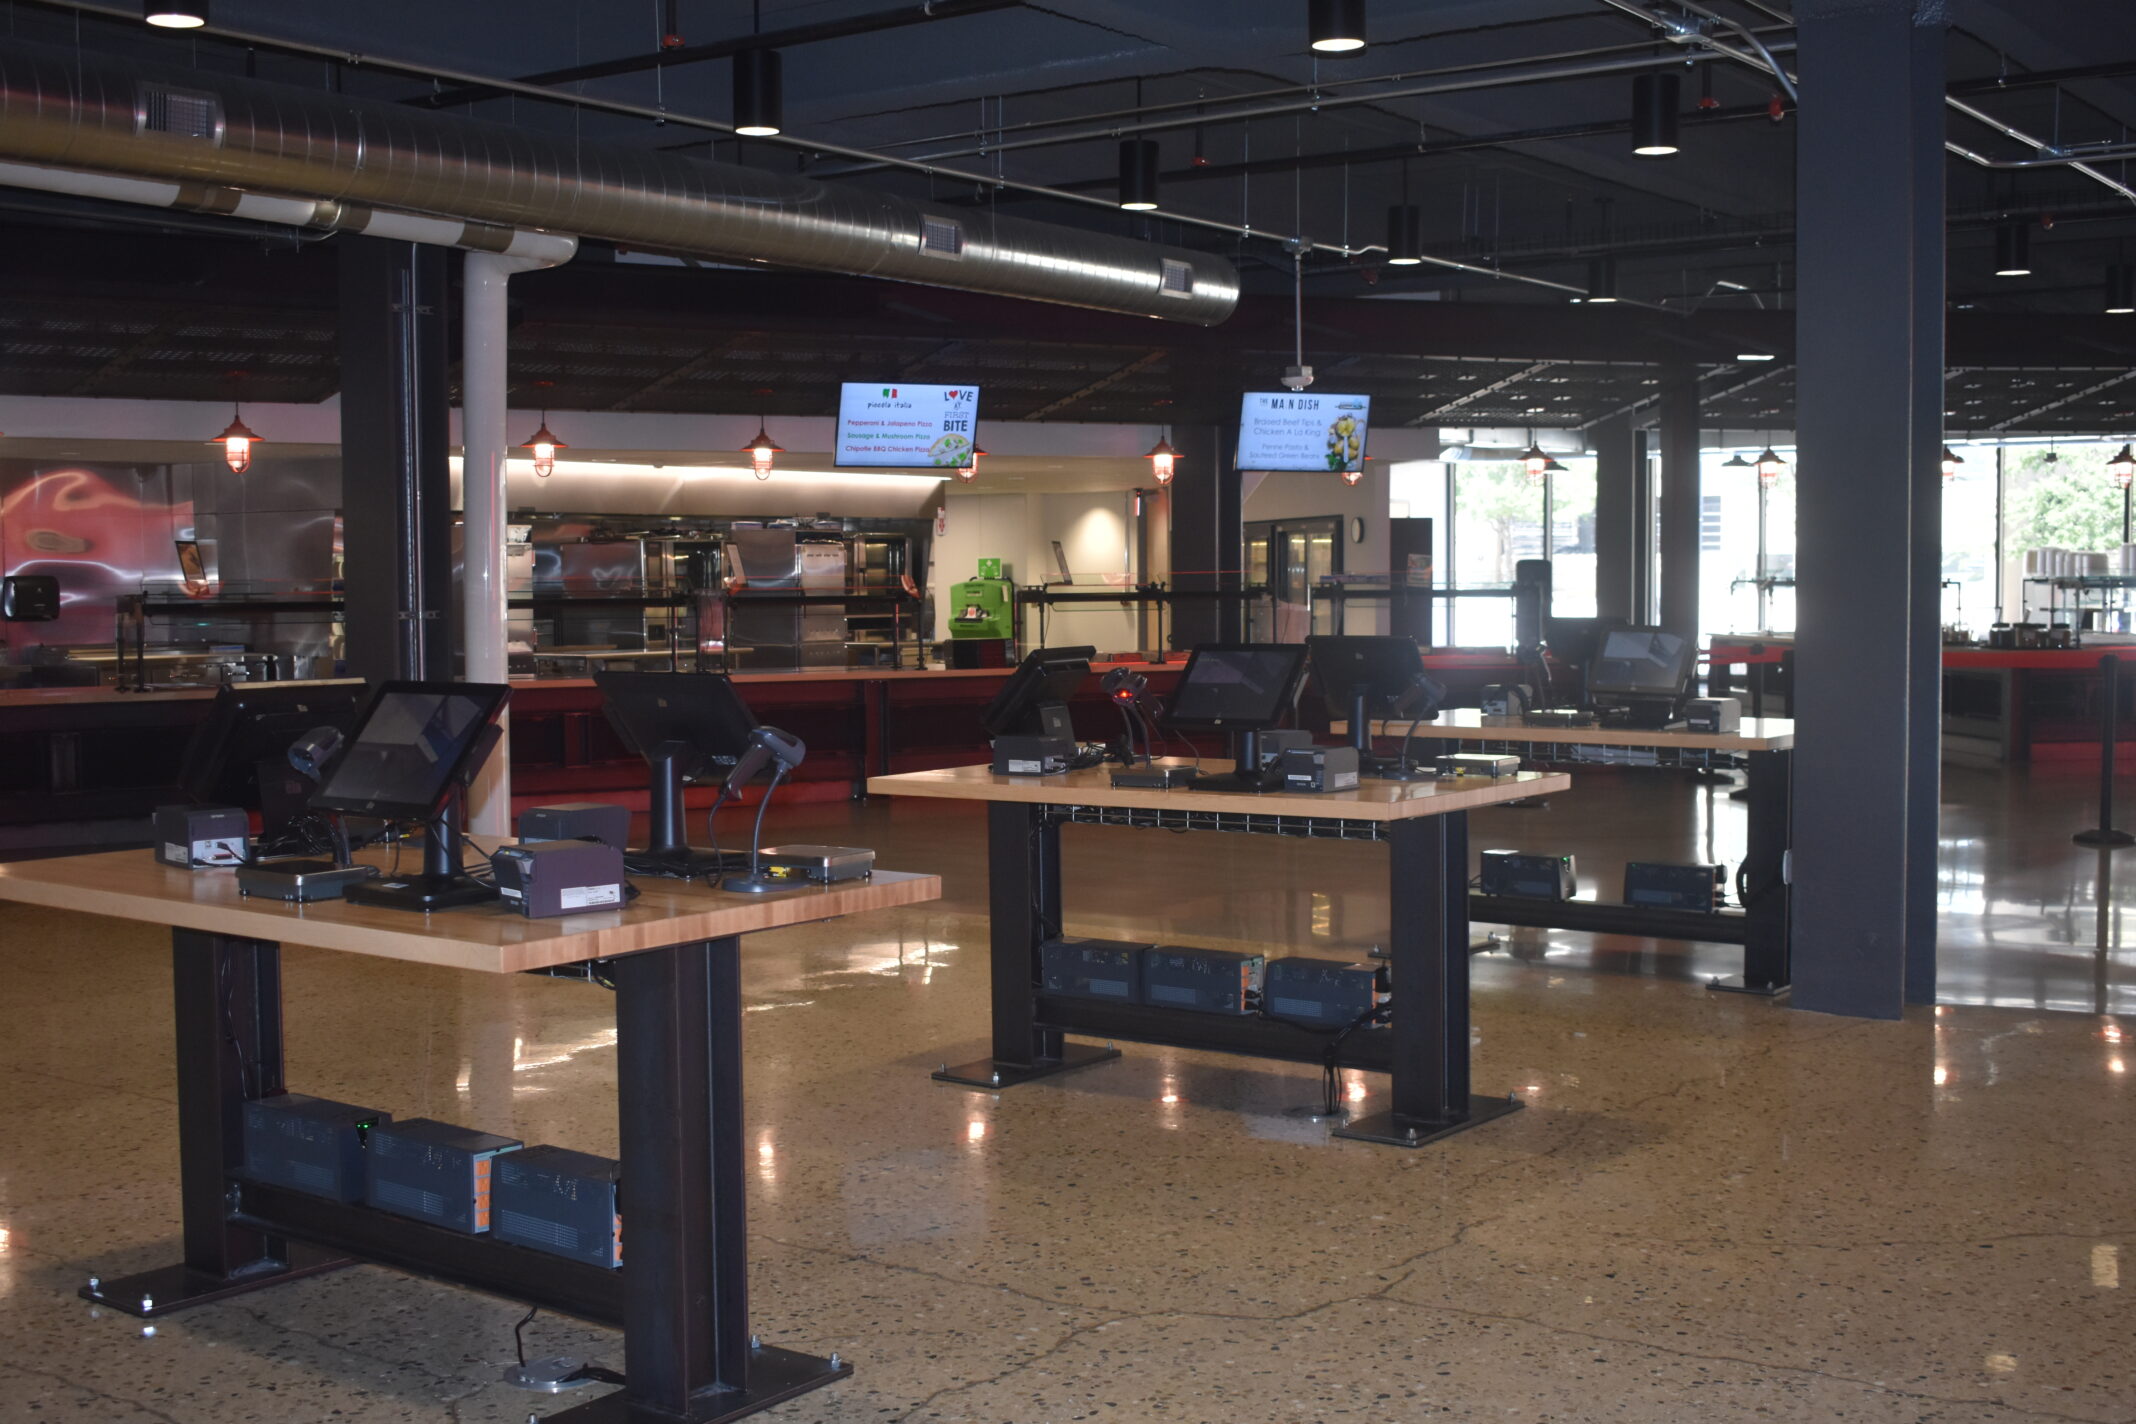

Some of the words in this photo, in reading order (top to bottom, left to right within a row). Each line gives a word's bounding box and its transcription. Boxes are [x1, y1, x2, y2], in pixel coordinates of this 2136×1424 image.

[1271, 398, 1295, 409] MAN
[1298, 399, 1319, 410] DISH
[944, 420, 968, 432] BITE
[1305, 428, 1320, 437] King
